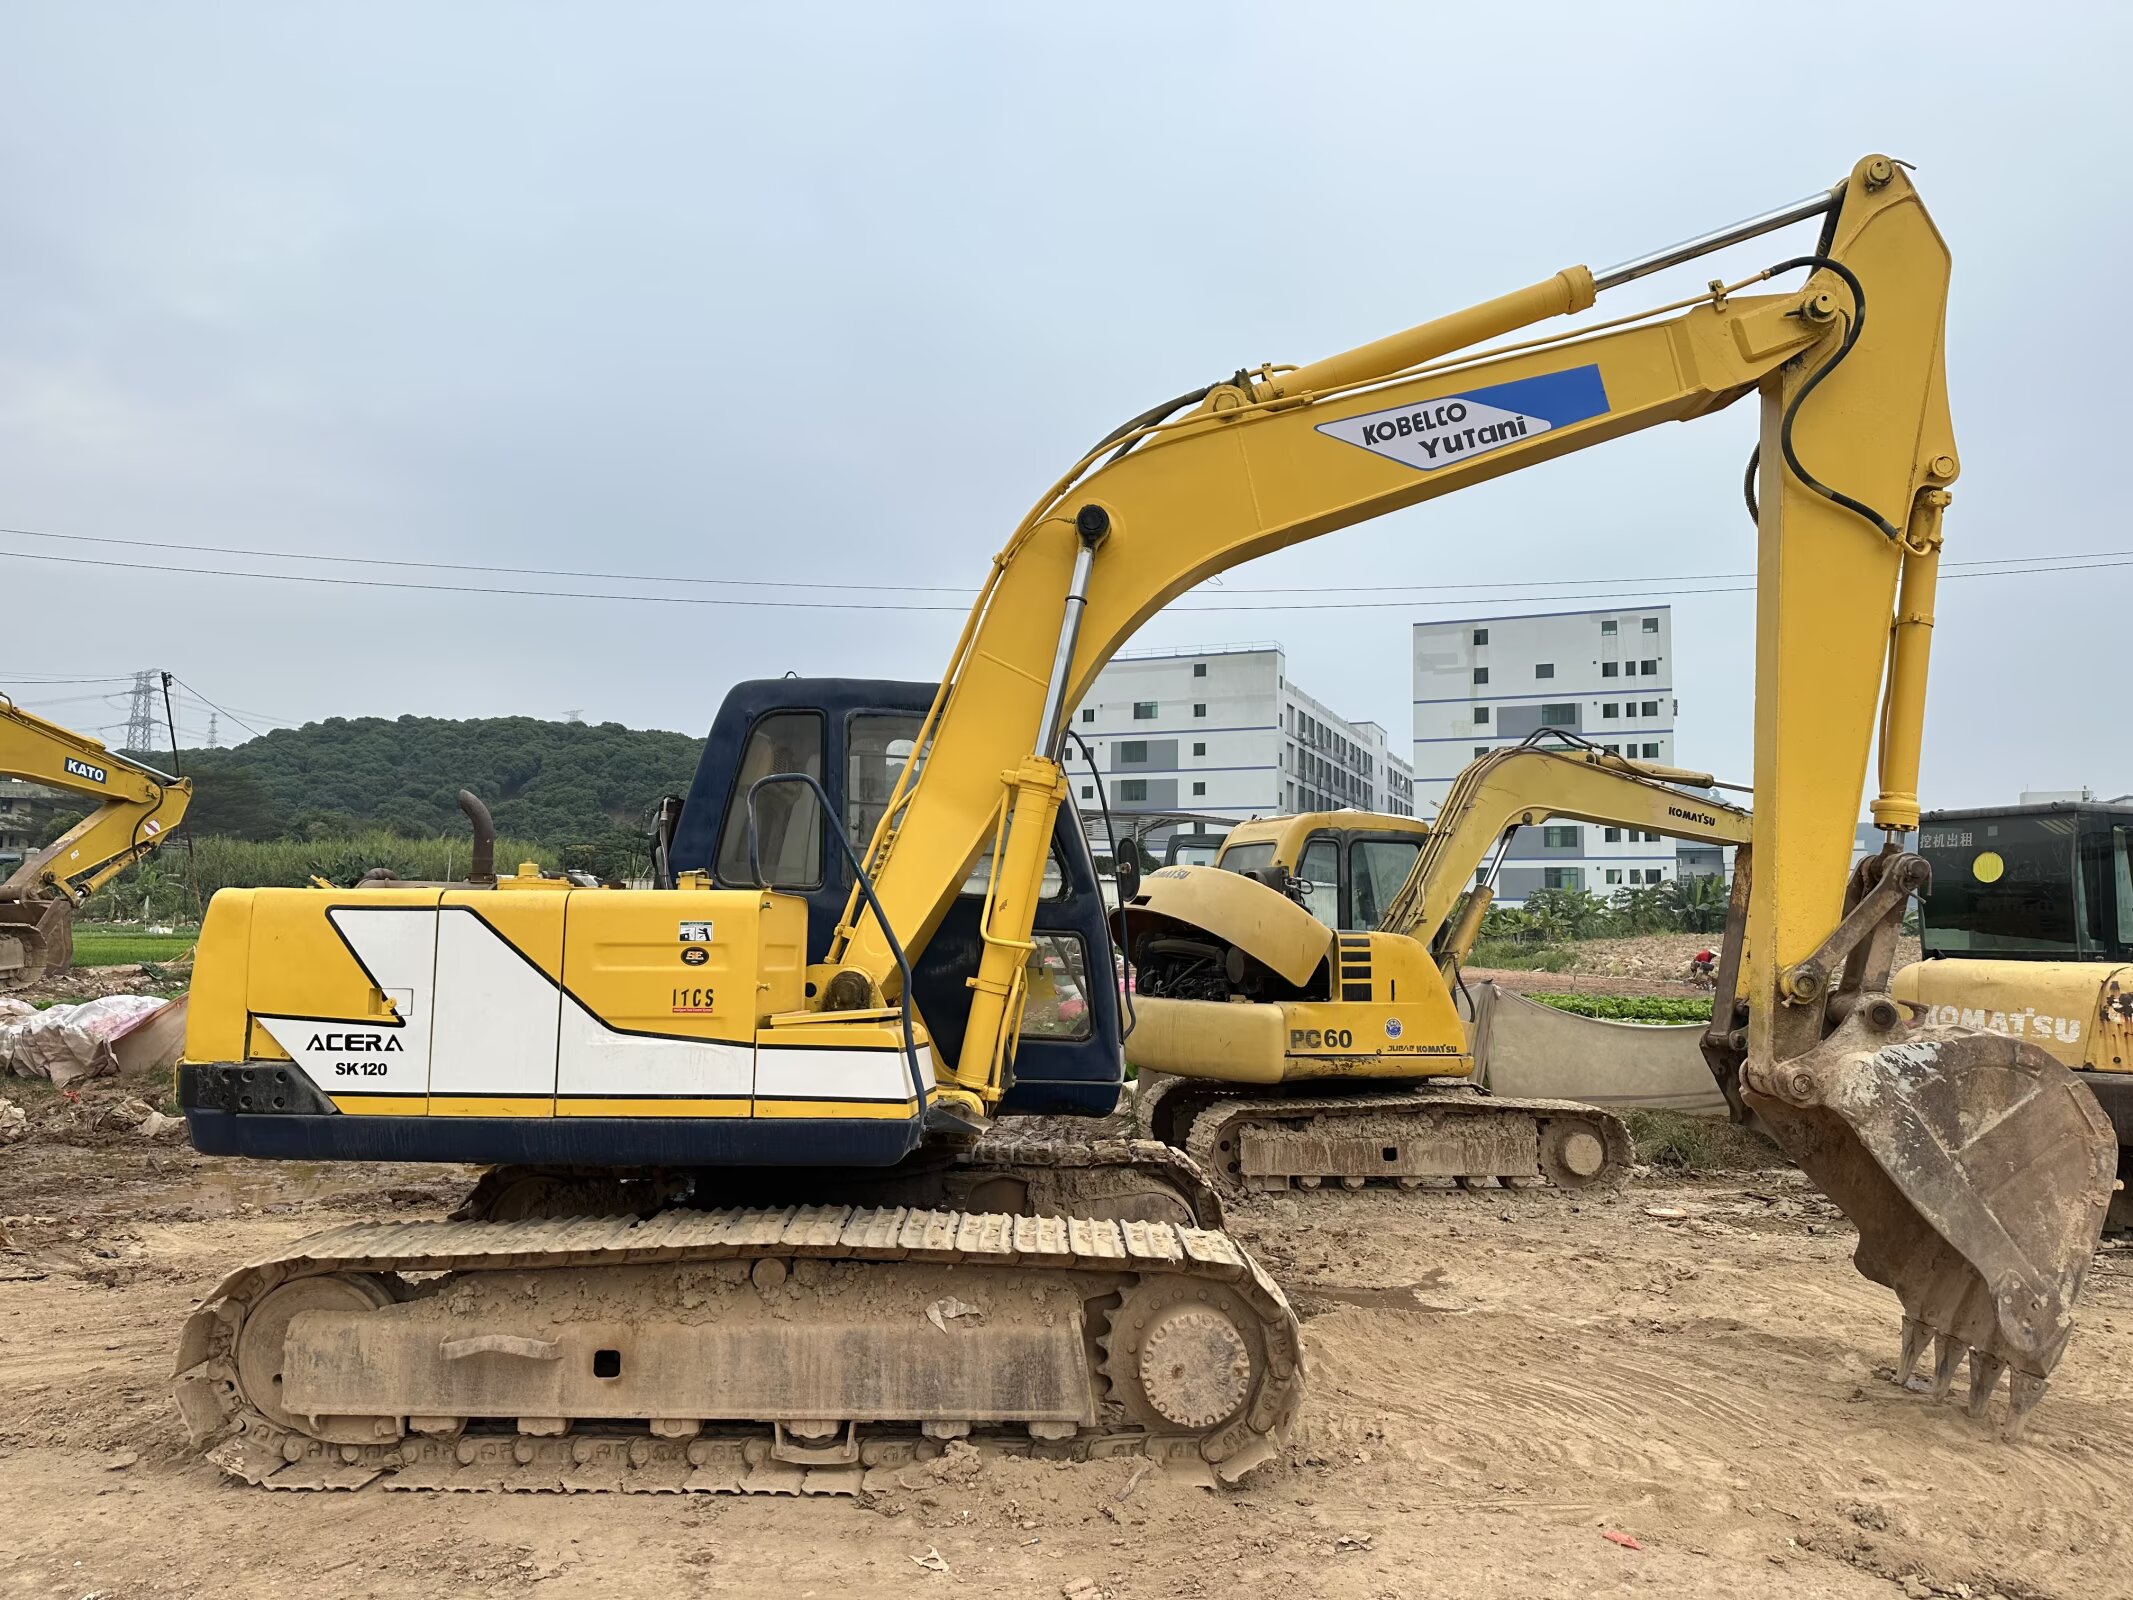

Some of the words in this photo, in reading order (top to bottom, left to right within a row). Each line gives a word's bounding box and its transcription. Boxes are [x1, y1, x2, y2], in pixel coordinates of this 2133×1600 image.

[1362, 402, 1467, 446] KOBELCO
[67, 759, 104, 782] KATO
[1668, 806, 1716, 827] KOMATSU
[1919, 832, 1973, 849] 挖机出租
[1146, 868, 1192, 880] MATSU
[672, 988, 714, 1007] ITCS
[1923, 1003, 2081, 1044] KOMATSU
[305, 1033, 404, 1052] ACERA
[1290, 1028, 1353, 1049] PC60
[1416, 1043, 1457, 1053] KOMATSU
[335, 1062, 388, 1076] SK120
